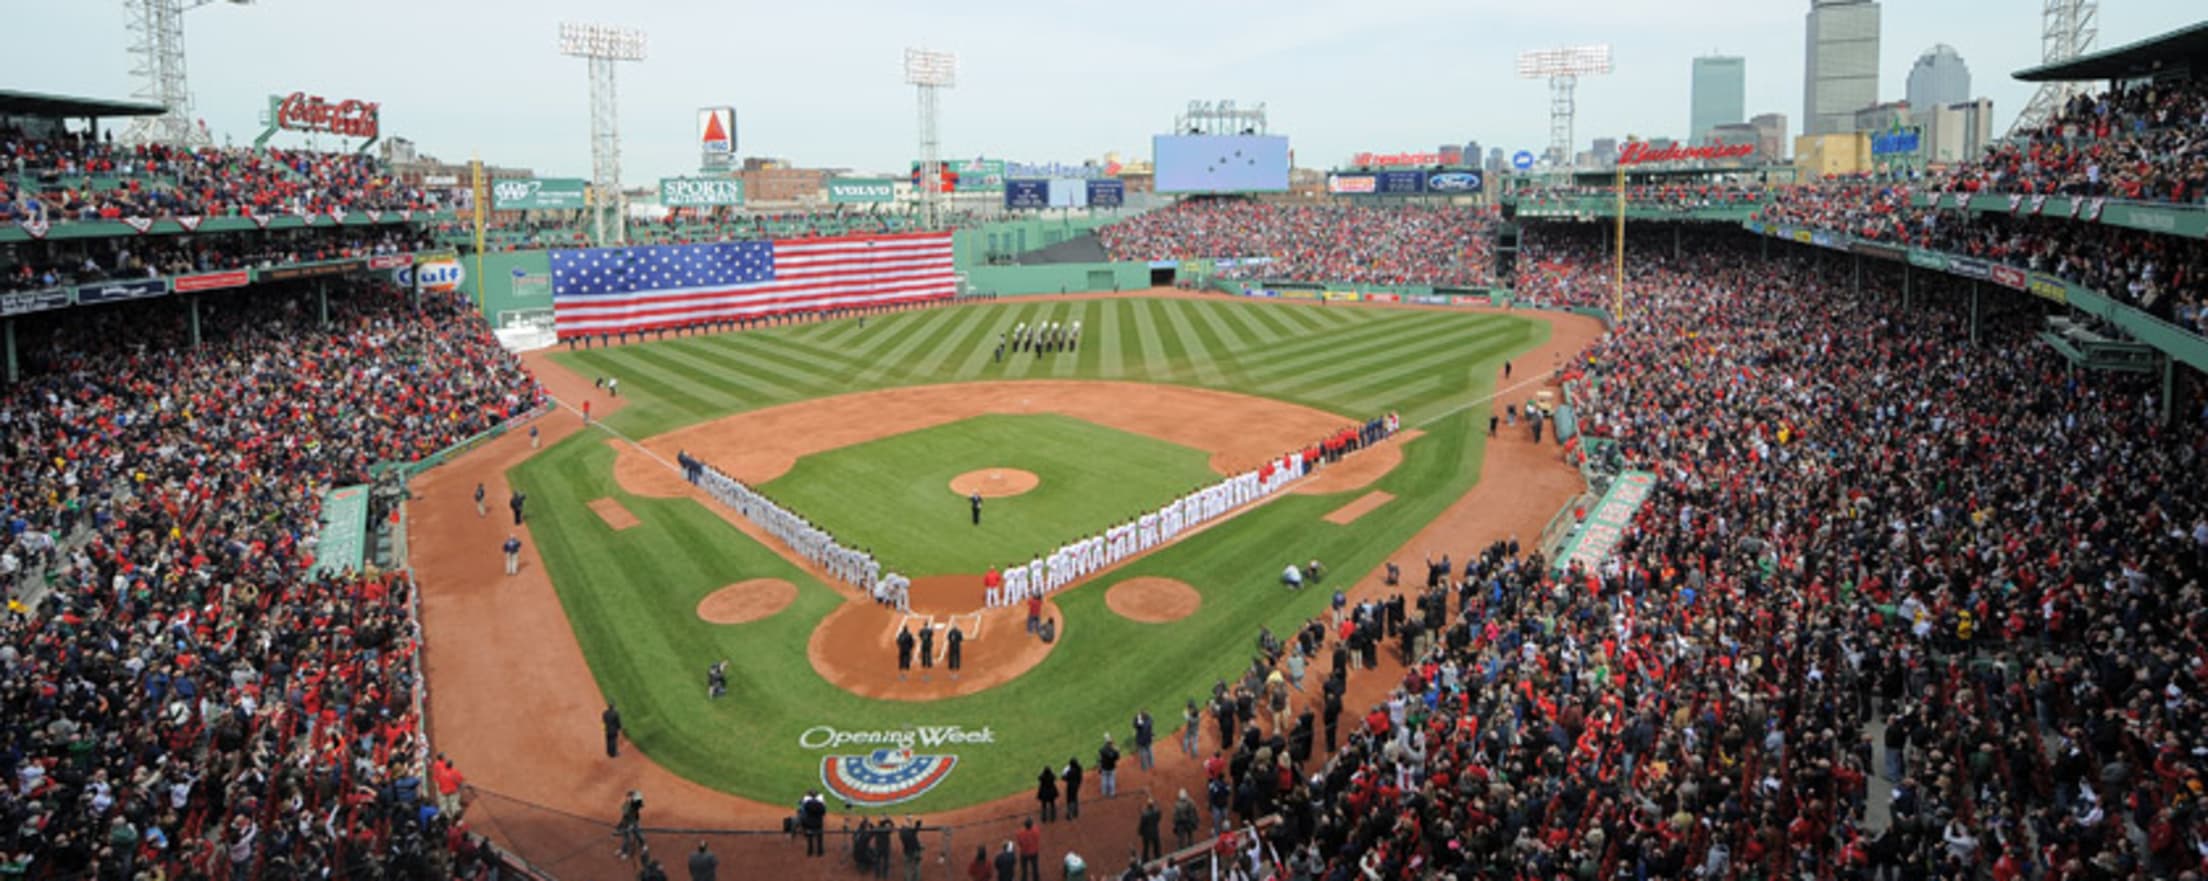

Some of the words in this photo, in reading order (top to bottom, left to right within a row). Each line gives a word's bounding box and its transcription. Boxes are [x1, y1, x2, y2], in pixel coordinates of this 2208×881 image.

[278, 92, 379, 137] Coca-Cola
[1619, 138, 1755, 165] Budweiser
[664, 181, 737, 195] SPORTS
[833, 186, 890, 196] VOLVO
[800, 725, 915, 749] Opening
[916, 725, 996, 747] Week
